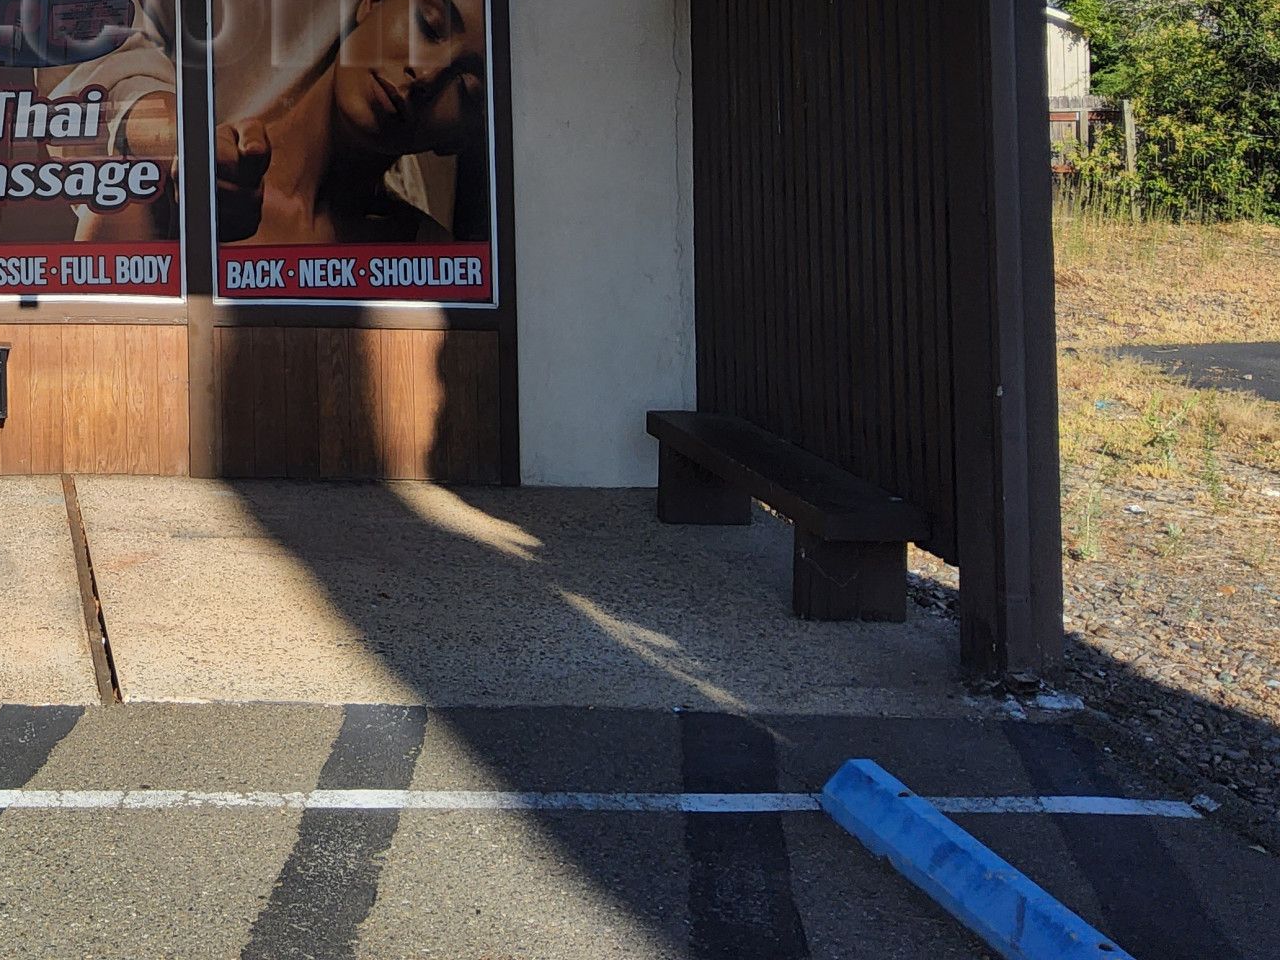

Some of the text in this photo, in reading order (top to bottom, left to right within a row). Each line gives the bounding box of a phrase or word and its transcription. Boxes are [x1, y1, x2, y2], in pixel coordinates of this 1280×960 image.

[60, 255, 113, 285] FULL
[114, 255, 172, 284] BODY
[226, 257, 483, 290] BACK NECK SHOULDER
